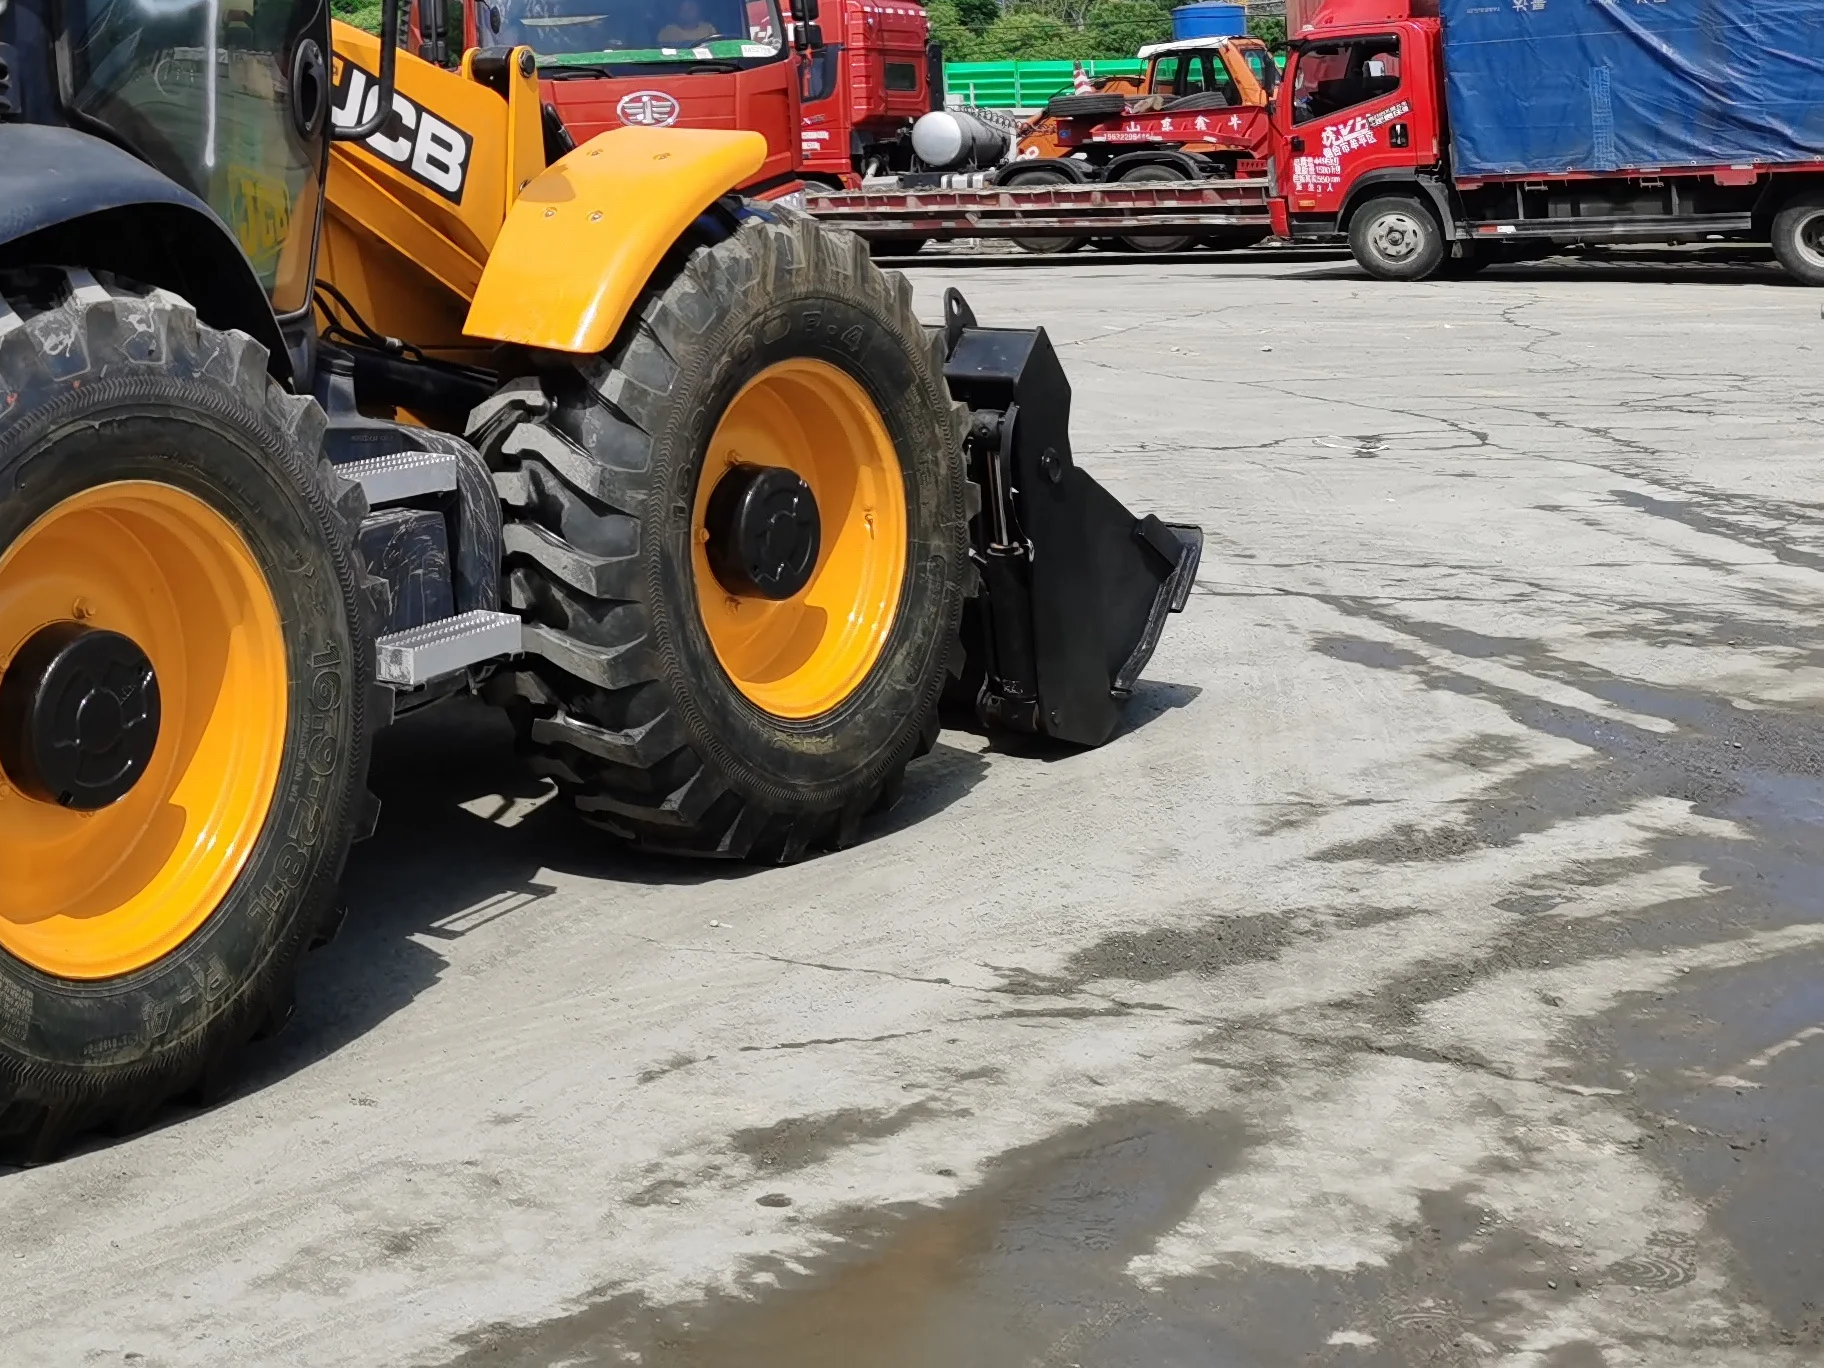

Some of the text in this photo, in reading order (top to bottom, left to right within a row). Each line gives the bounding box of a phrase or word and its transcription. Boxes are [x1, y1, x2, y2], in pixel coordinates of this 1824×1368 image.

[331, 68, 466, 193] JCB
[1126, 113, 1242, 132] 山东鑫牛
[273, 641, 343, 890] 16.9-28
